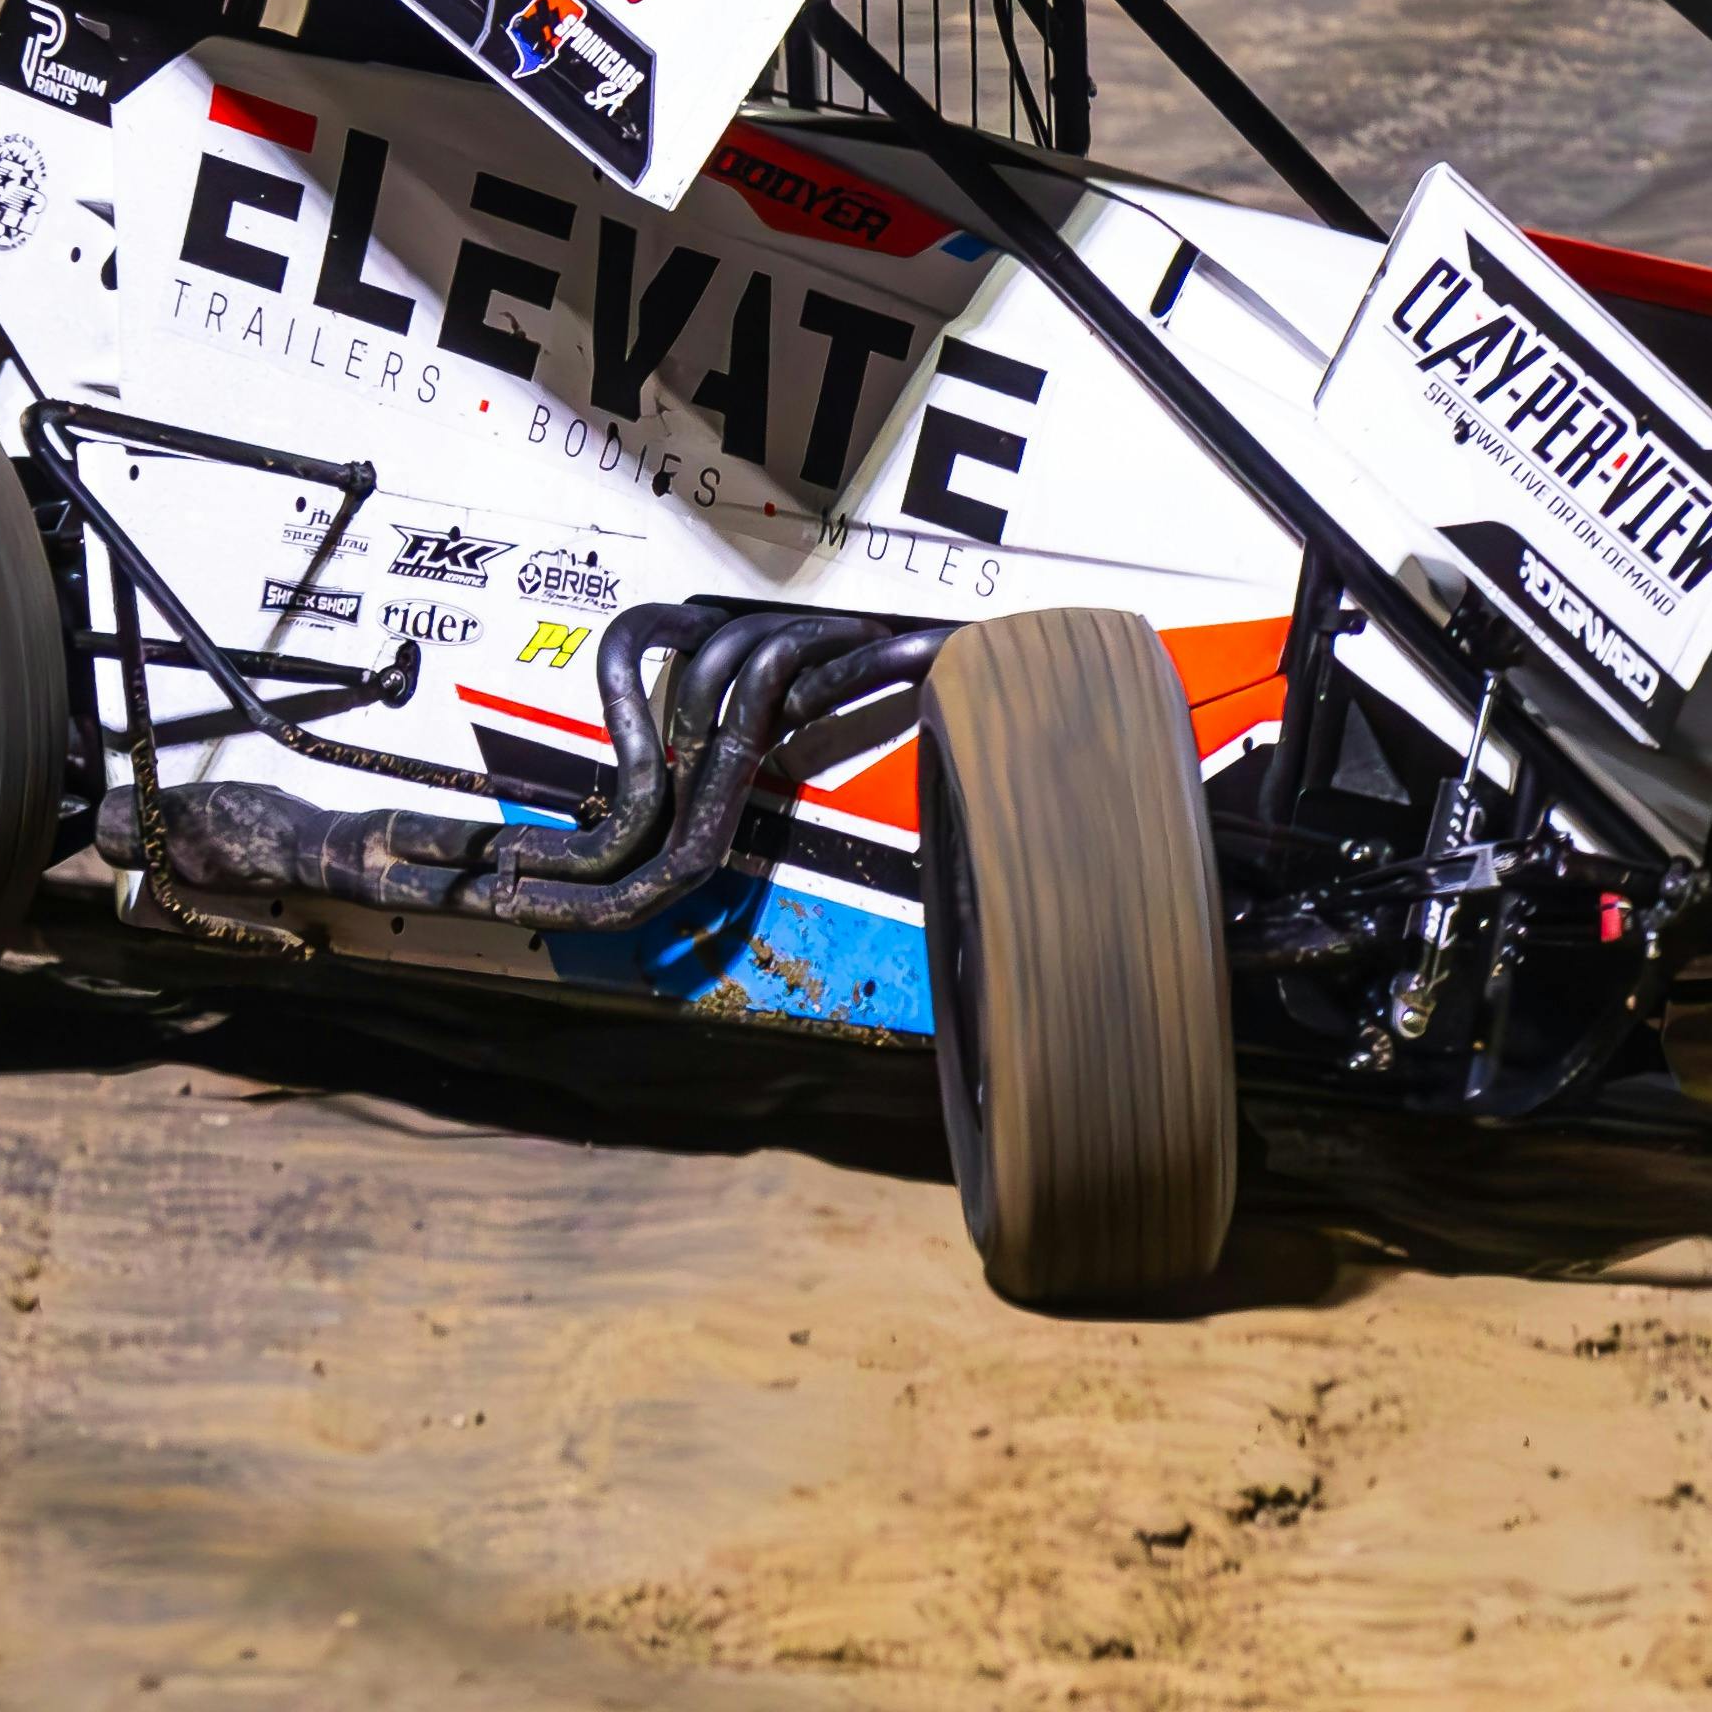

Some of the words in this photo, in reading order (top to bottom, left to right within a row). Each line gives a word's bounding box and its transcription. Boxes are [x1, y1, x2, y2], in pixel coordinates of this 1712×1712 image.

[554, 14, 645, 95] SPRINTCARS
[584, 80, 629, 118] SA
[709, 145, 891, 243] OODYER
[179, 84, 1048, 545] ELEVATE
[172, 278, 443, 405] TRAILERS
[527, 404, 722, 508] BODIES
[818, 508, 1001, 597] MULES
[1424, 381, 1511, 468] SPEEDWAY
[1510, 462, 1547, 503] LIVE
[1548, 495, 1575, 525] OR
[317, 595, 358, 618] SHOP
[382, 602, 478, 642] rider
[543, 566, 621, 602] BRISK
